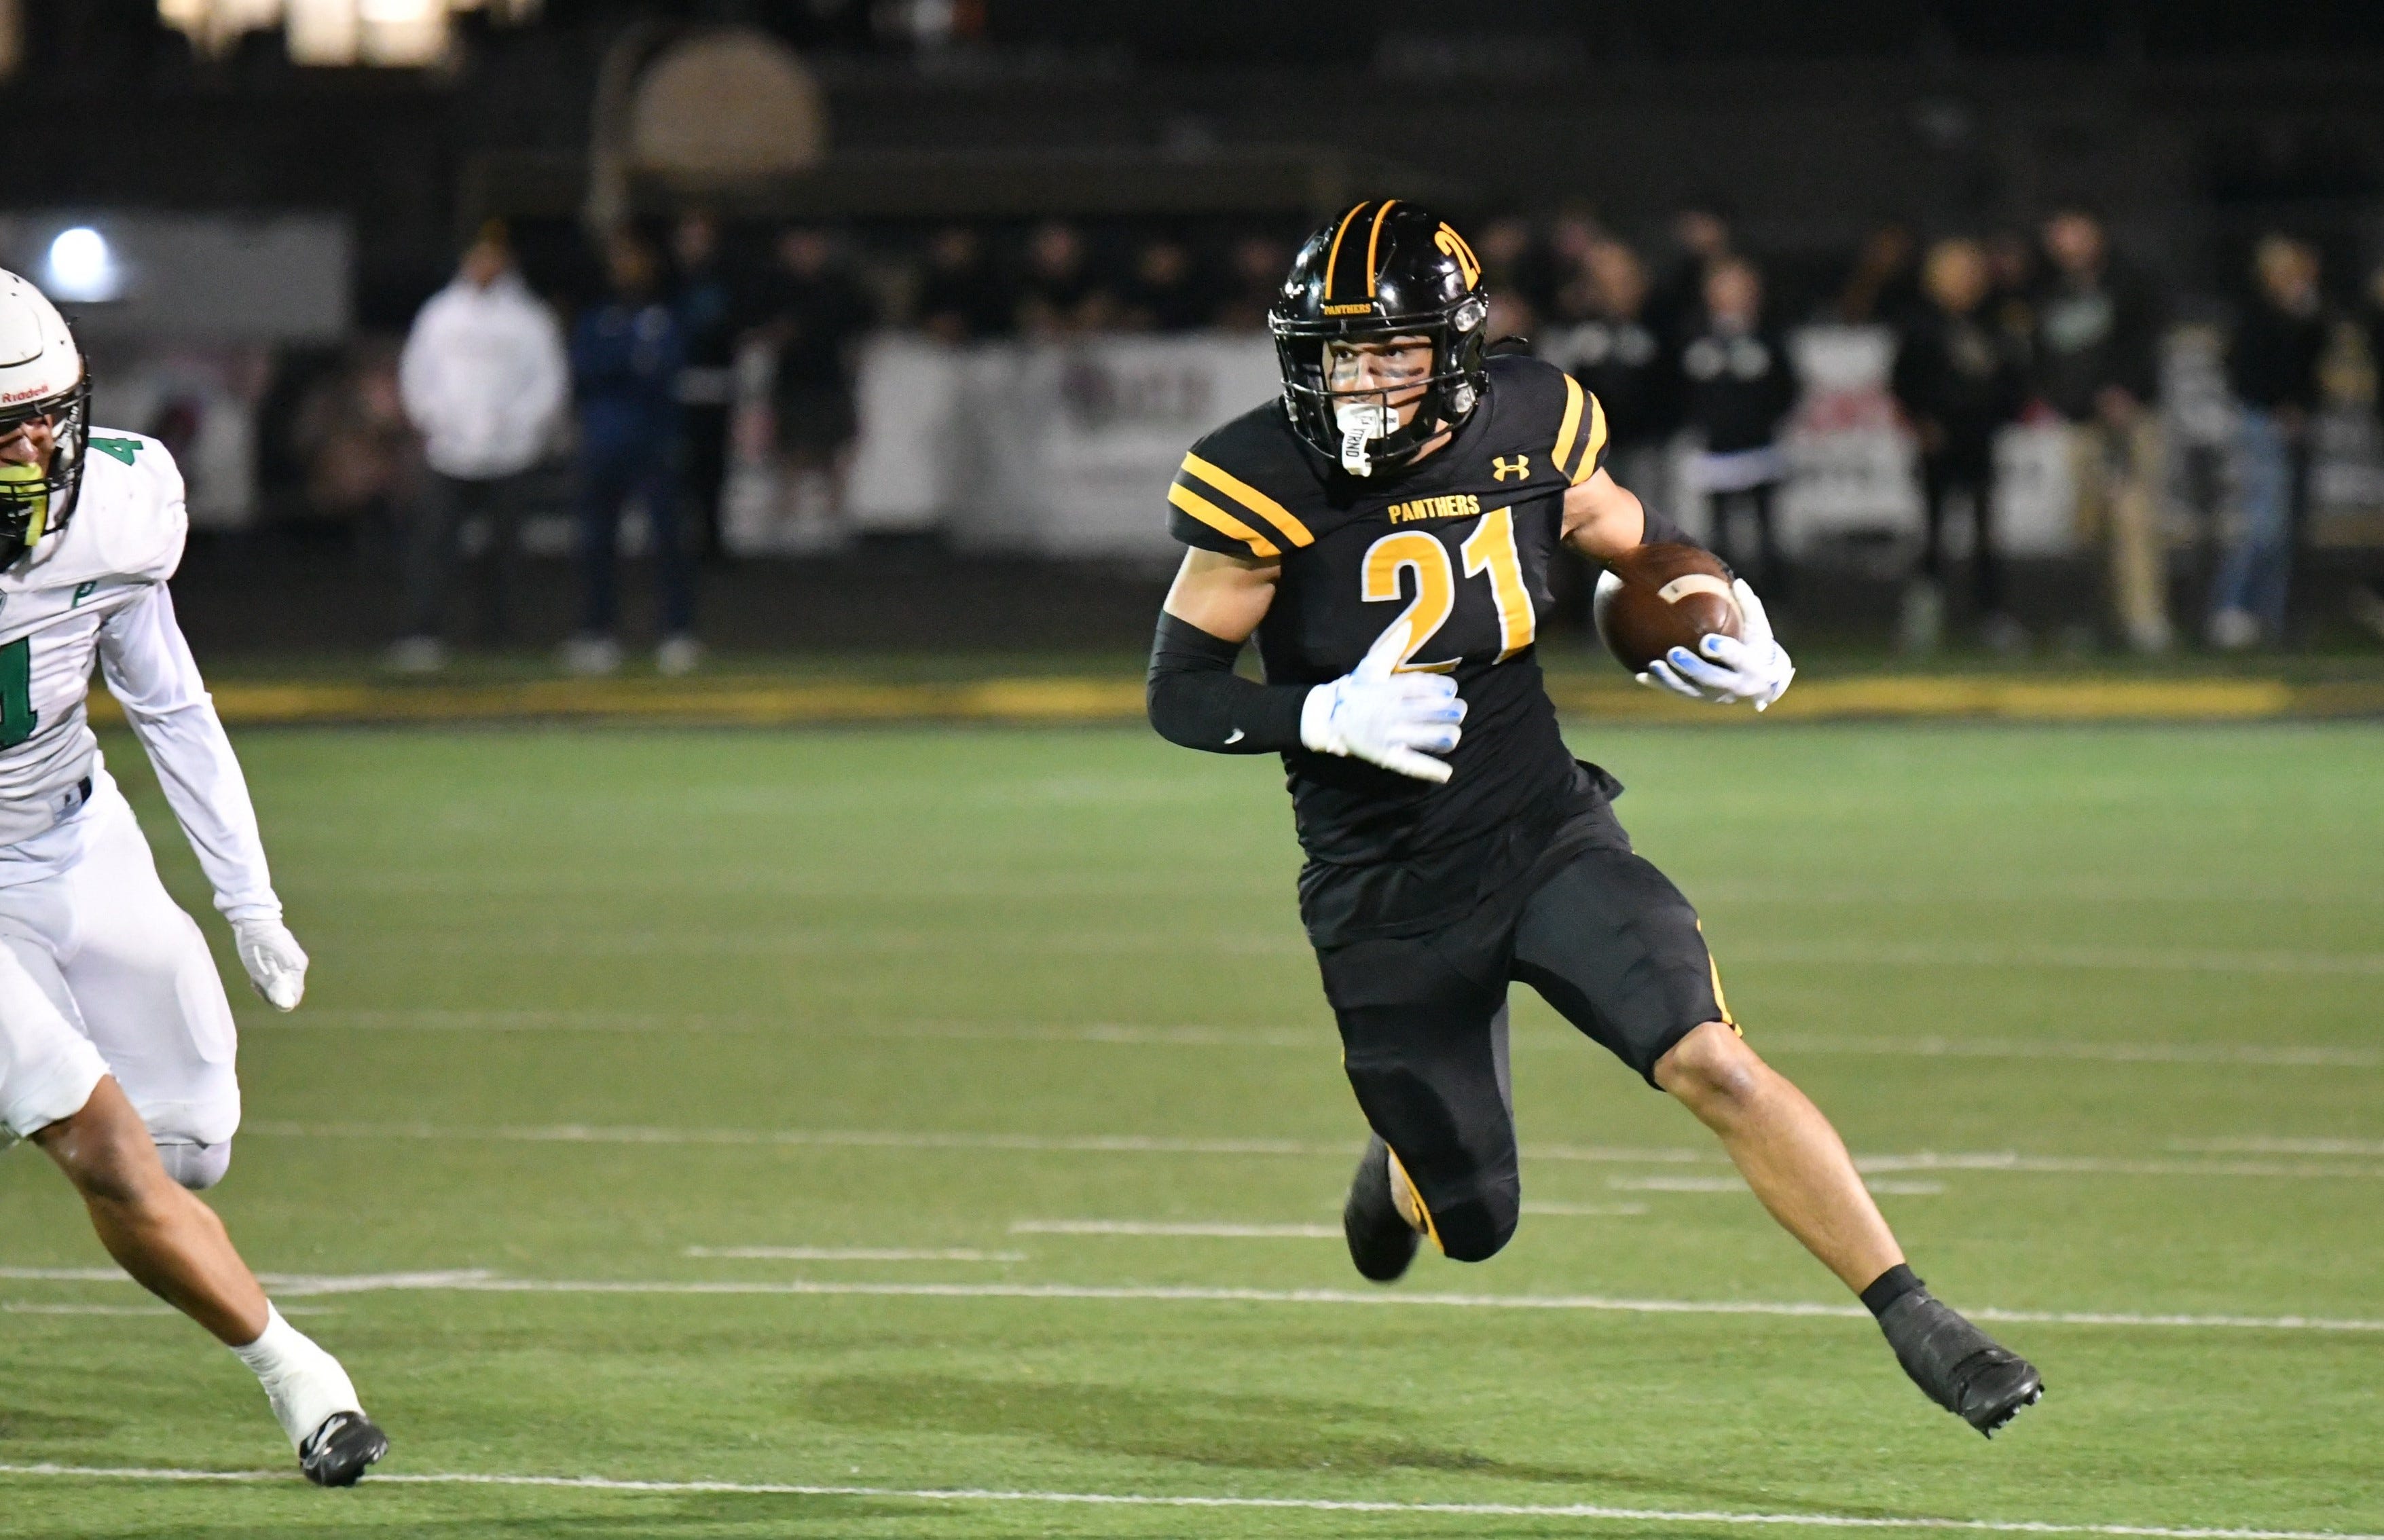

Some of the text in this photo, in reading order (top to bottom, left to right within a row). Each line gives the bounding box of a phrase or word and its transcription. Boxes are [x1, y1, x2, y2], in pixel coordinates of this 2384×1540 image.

[1434, 221, 1482, 292] 21
[1324, 304, 1372, 316] PANTHERS
[88, 437, 144, 466] 4
[1388, 494, 1480, 524] PANTHERS
[1361, 506, 1536, 673] 21
